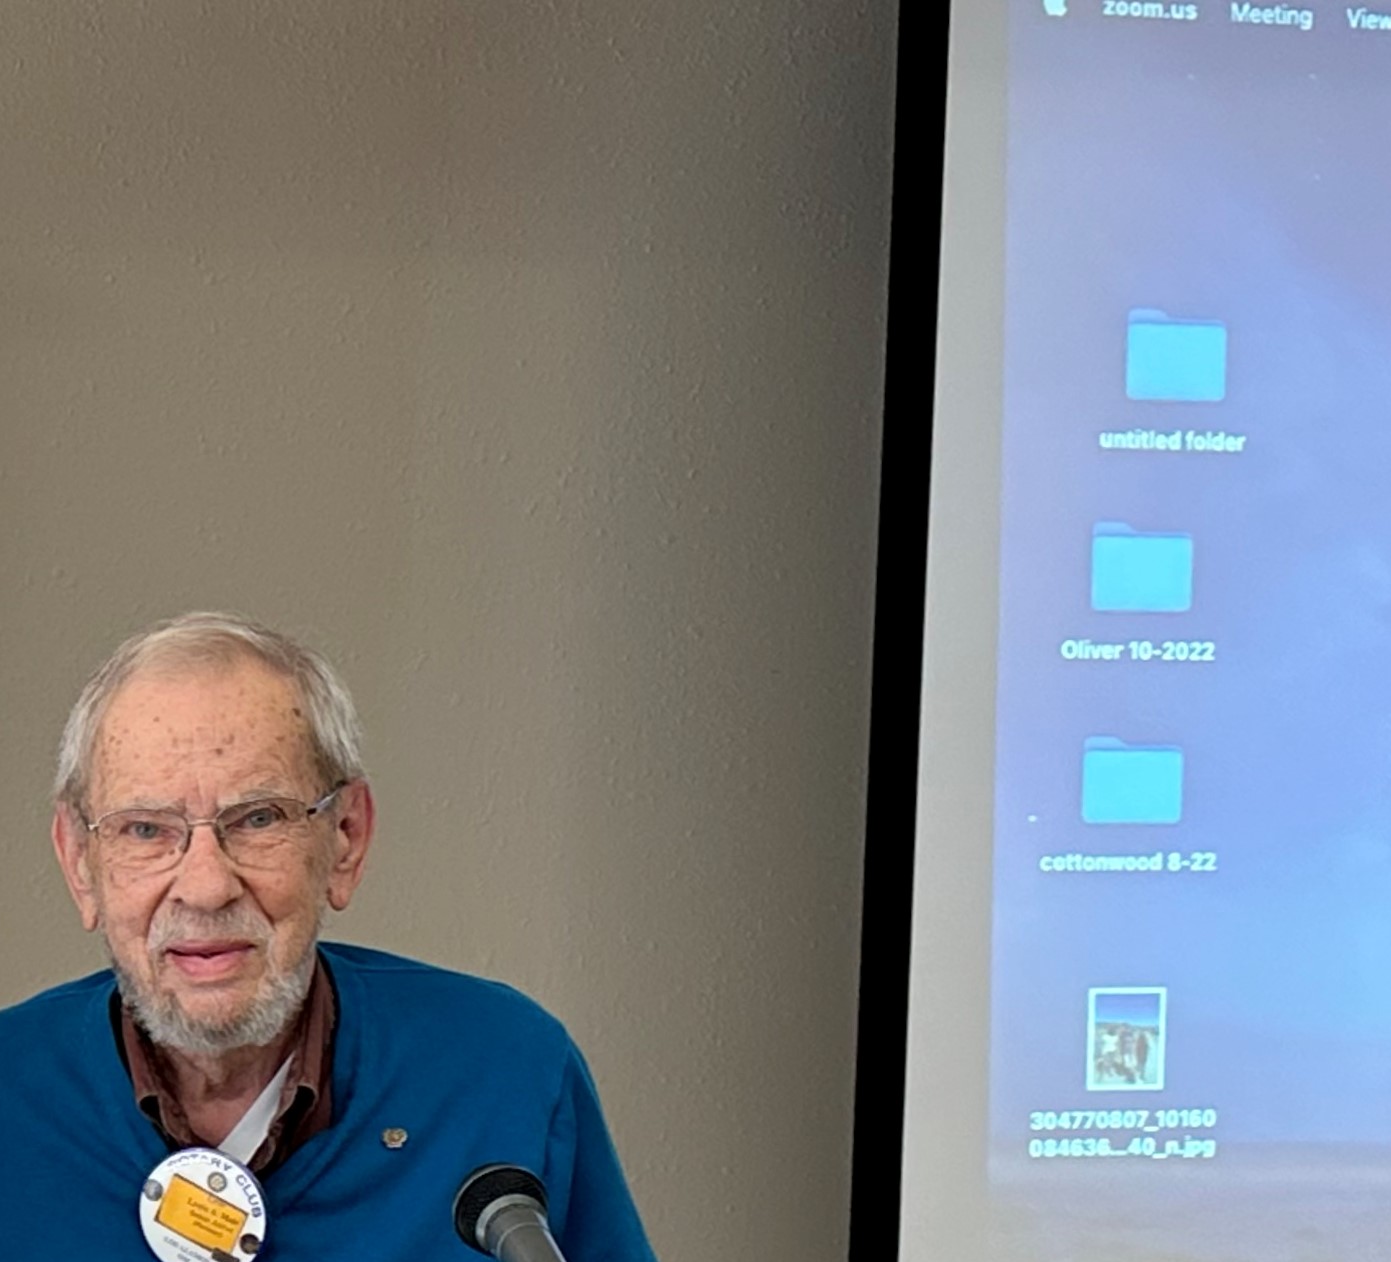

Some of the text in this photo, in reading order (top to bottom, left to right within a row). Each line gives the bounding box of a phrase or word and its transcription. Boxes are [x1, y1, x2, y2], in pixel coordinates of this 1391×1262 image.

[1103, 0, 1198, 20] zoom.us
[1230, 2, 1313, 30] Meeting
[1099, 429, 1246, 452] untitled folder
[1061, 639, 1215, 662] Oliver 10-2022
[1040, 852, 1217, 872] cottonwood 8-22
